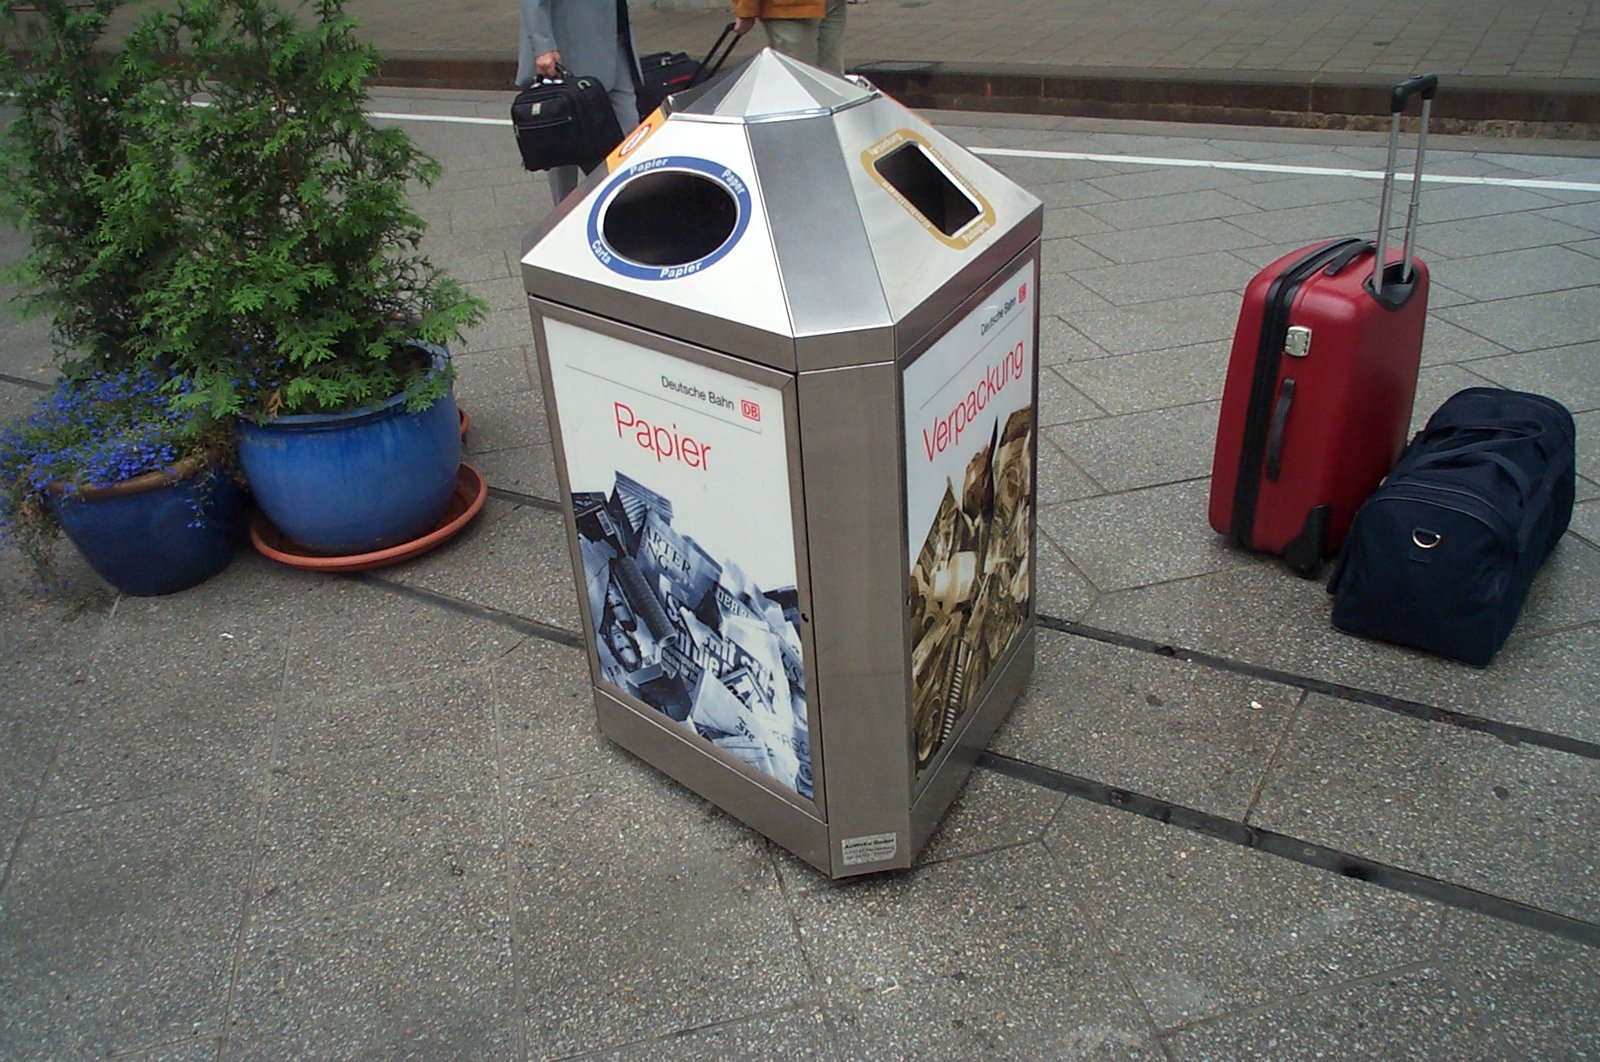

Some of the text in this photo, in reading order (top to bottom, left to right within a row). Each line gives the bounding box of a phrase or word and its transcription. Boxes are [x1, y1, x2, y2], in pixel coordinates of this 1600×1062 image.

[629, 158, 669, 176] Papier
[721, 168, 746, 195] Paper
[591, 239, 612, 265] Carta
[659, 261, 703, 279] Papier
[981, 296, 1016, 336] Deutsche Bahn
[661, 376, 761, 422] Deutsche Bahn DB
[923, 340, 1024, 462] Verpackung
[614, 402, 711, 471] Papier
